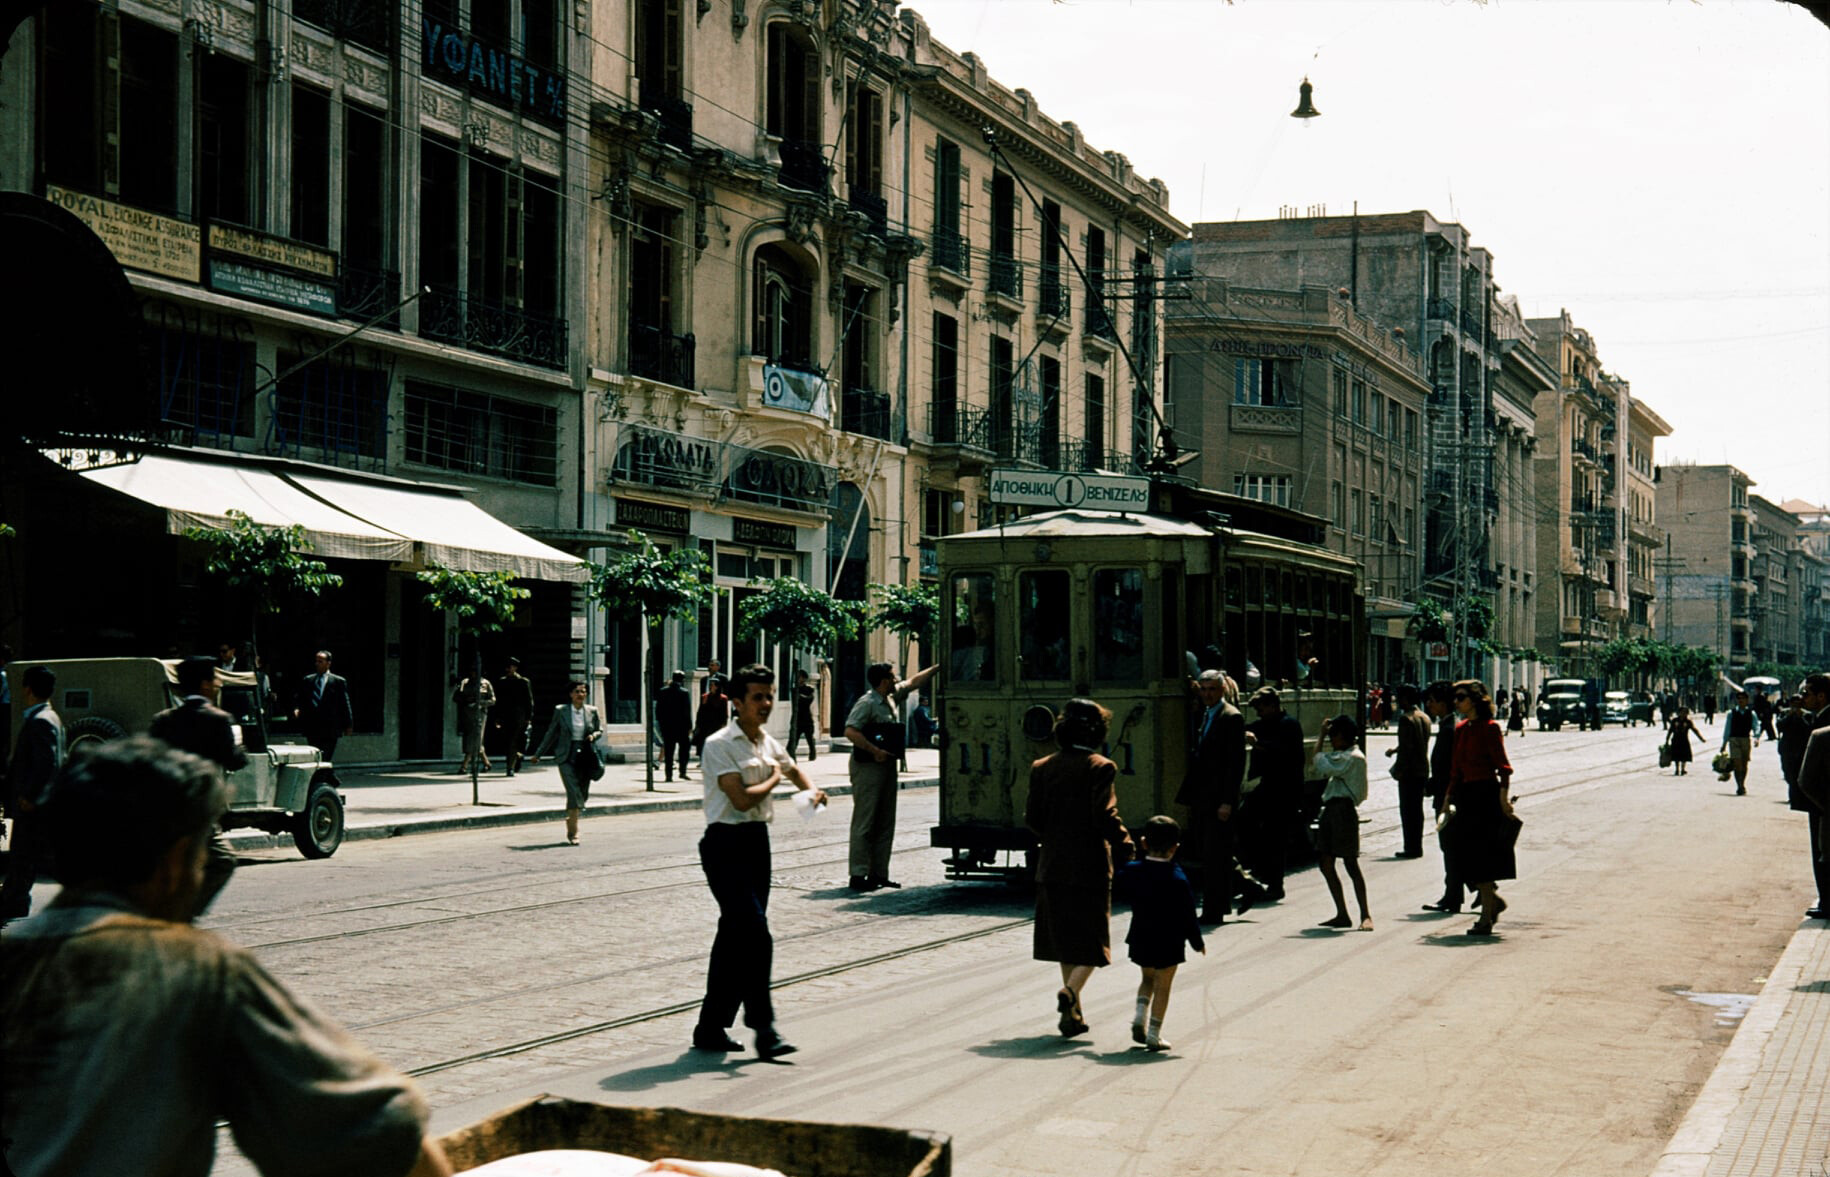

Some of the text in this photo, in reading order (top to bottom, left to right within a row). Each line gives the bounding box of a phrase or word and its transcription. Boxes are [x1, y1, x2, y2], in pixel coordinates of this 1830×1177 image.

[423, 18, 539, 106] ΥΦΑΝΕΤ
[156, 218, 201, 243] ASSURANCE
[992, 480, 1055, 497] ΑΠΟΘΗΚΗ
[1065, 479, 1074, 503] 1
[959, 743, 992, 775] 11
